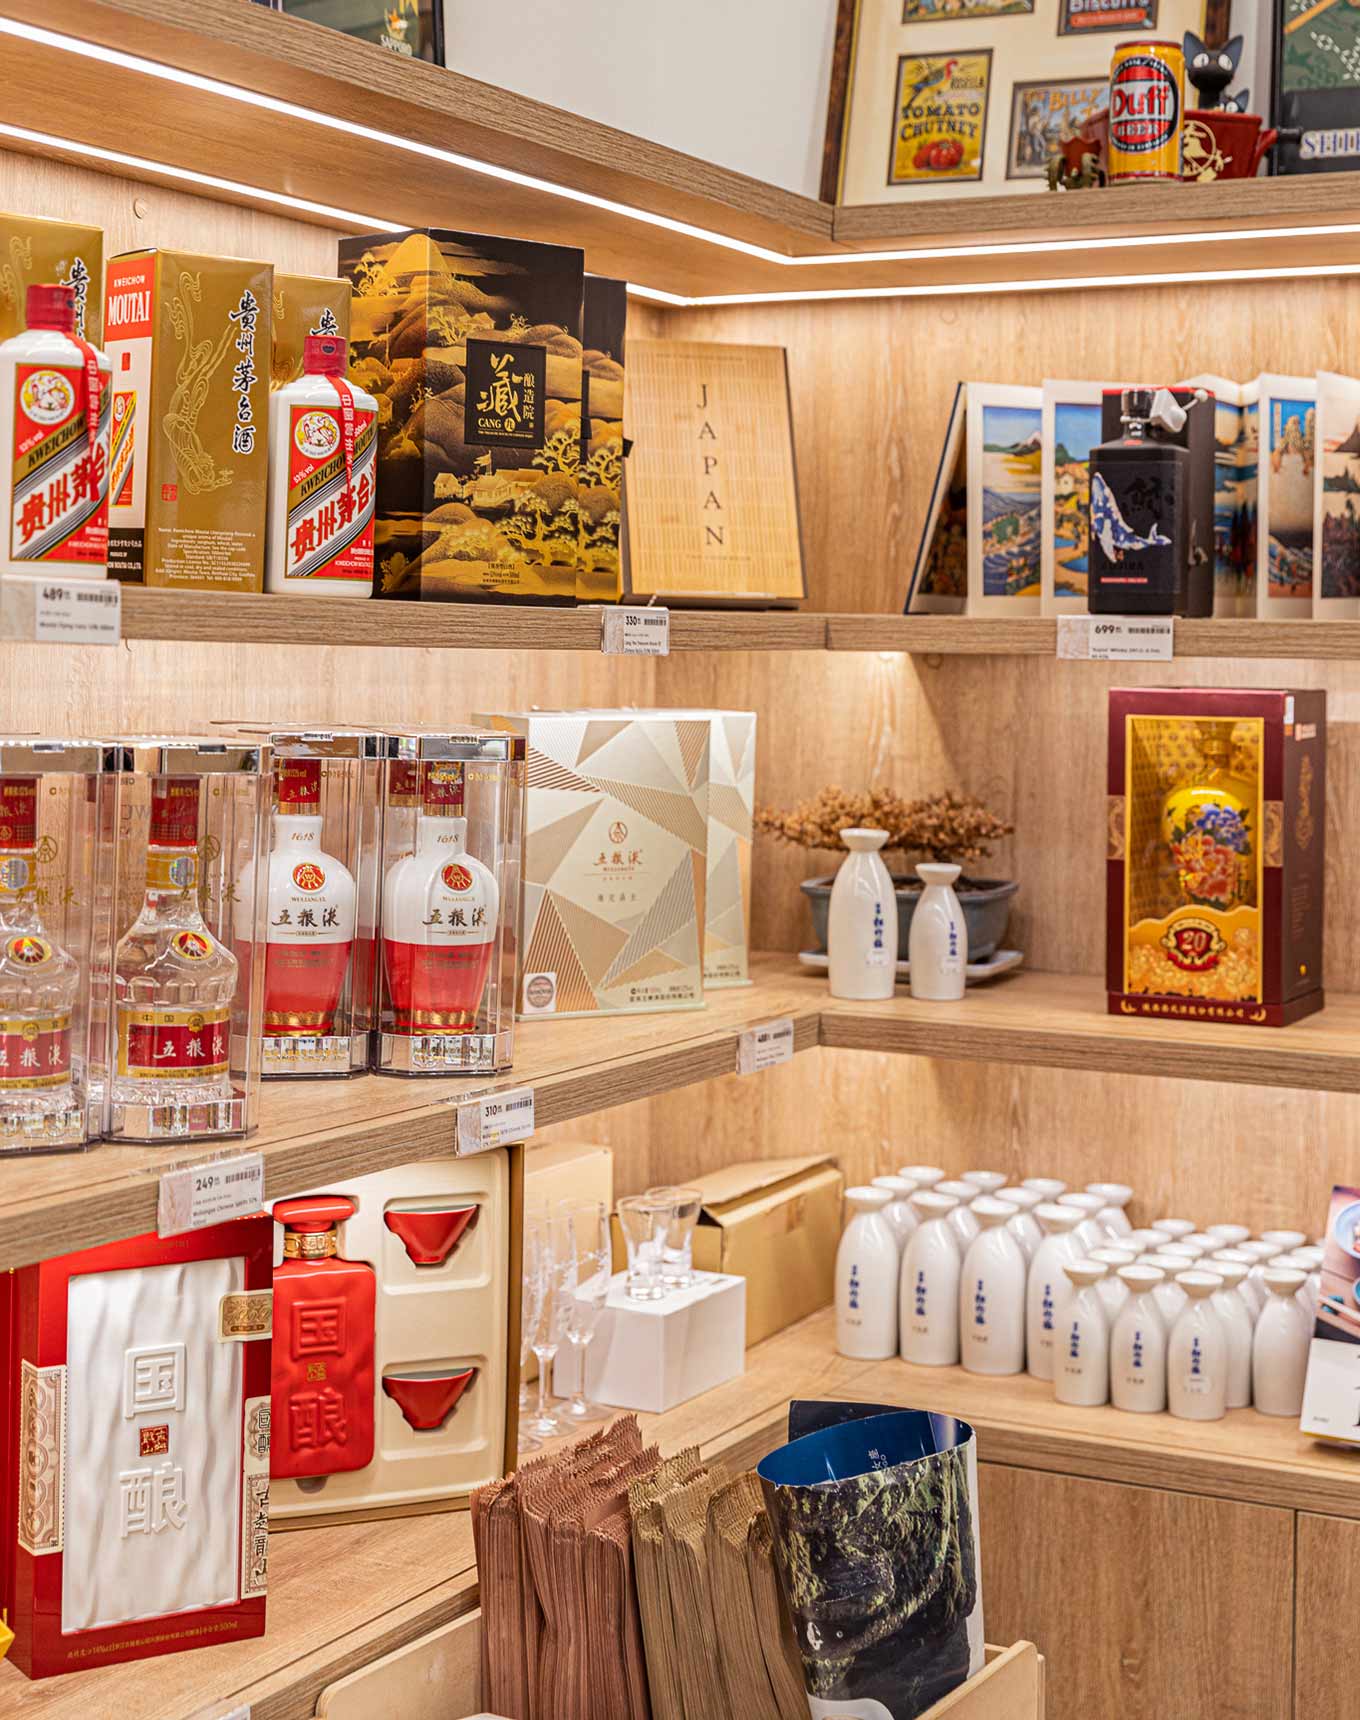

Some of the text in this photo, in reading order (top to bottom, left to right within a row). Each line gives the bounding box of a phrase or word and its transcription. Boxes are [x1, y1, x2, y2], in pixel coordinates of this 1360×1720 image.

[1112, 85, 1169, 118] Duff
[902, 103, 980, 119] TOMATO
[901, 119, 978, 141] CHUTNEY
[1118, 124, 1158, 135] BEER
[114, 275, 145, 288] KWEICHOW
[107, 290, 151, 327] MOUTAI
[478, 417, 501, 428] CANG
[28, 413, 85, 468] KWEICHOW
[697, 384, 724, 546] JAPAN
[16, 430, 109, 545] 贵州茅台
[43, 588, 63, 600] 489
[626, 616, 638, 626] 330
[1095, 624, 1115, 634] 699
[290, 832, 315, 841] 1618
[437, 834, 460, 844] 1618
[1181, 931, 1208, 951] 20
[485, 1105, 498, 1117] 310
[196, 1176, 214, 1192] 249
